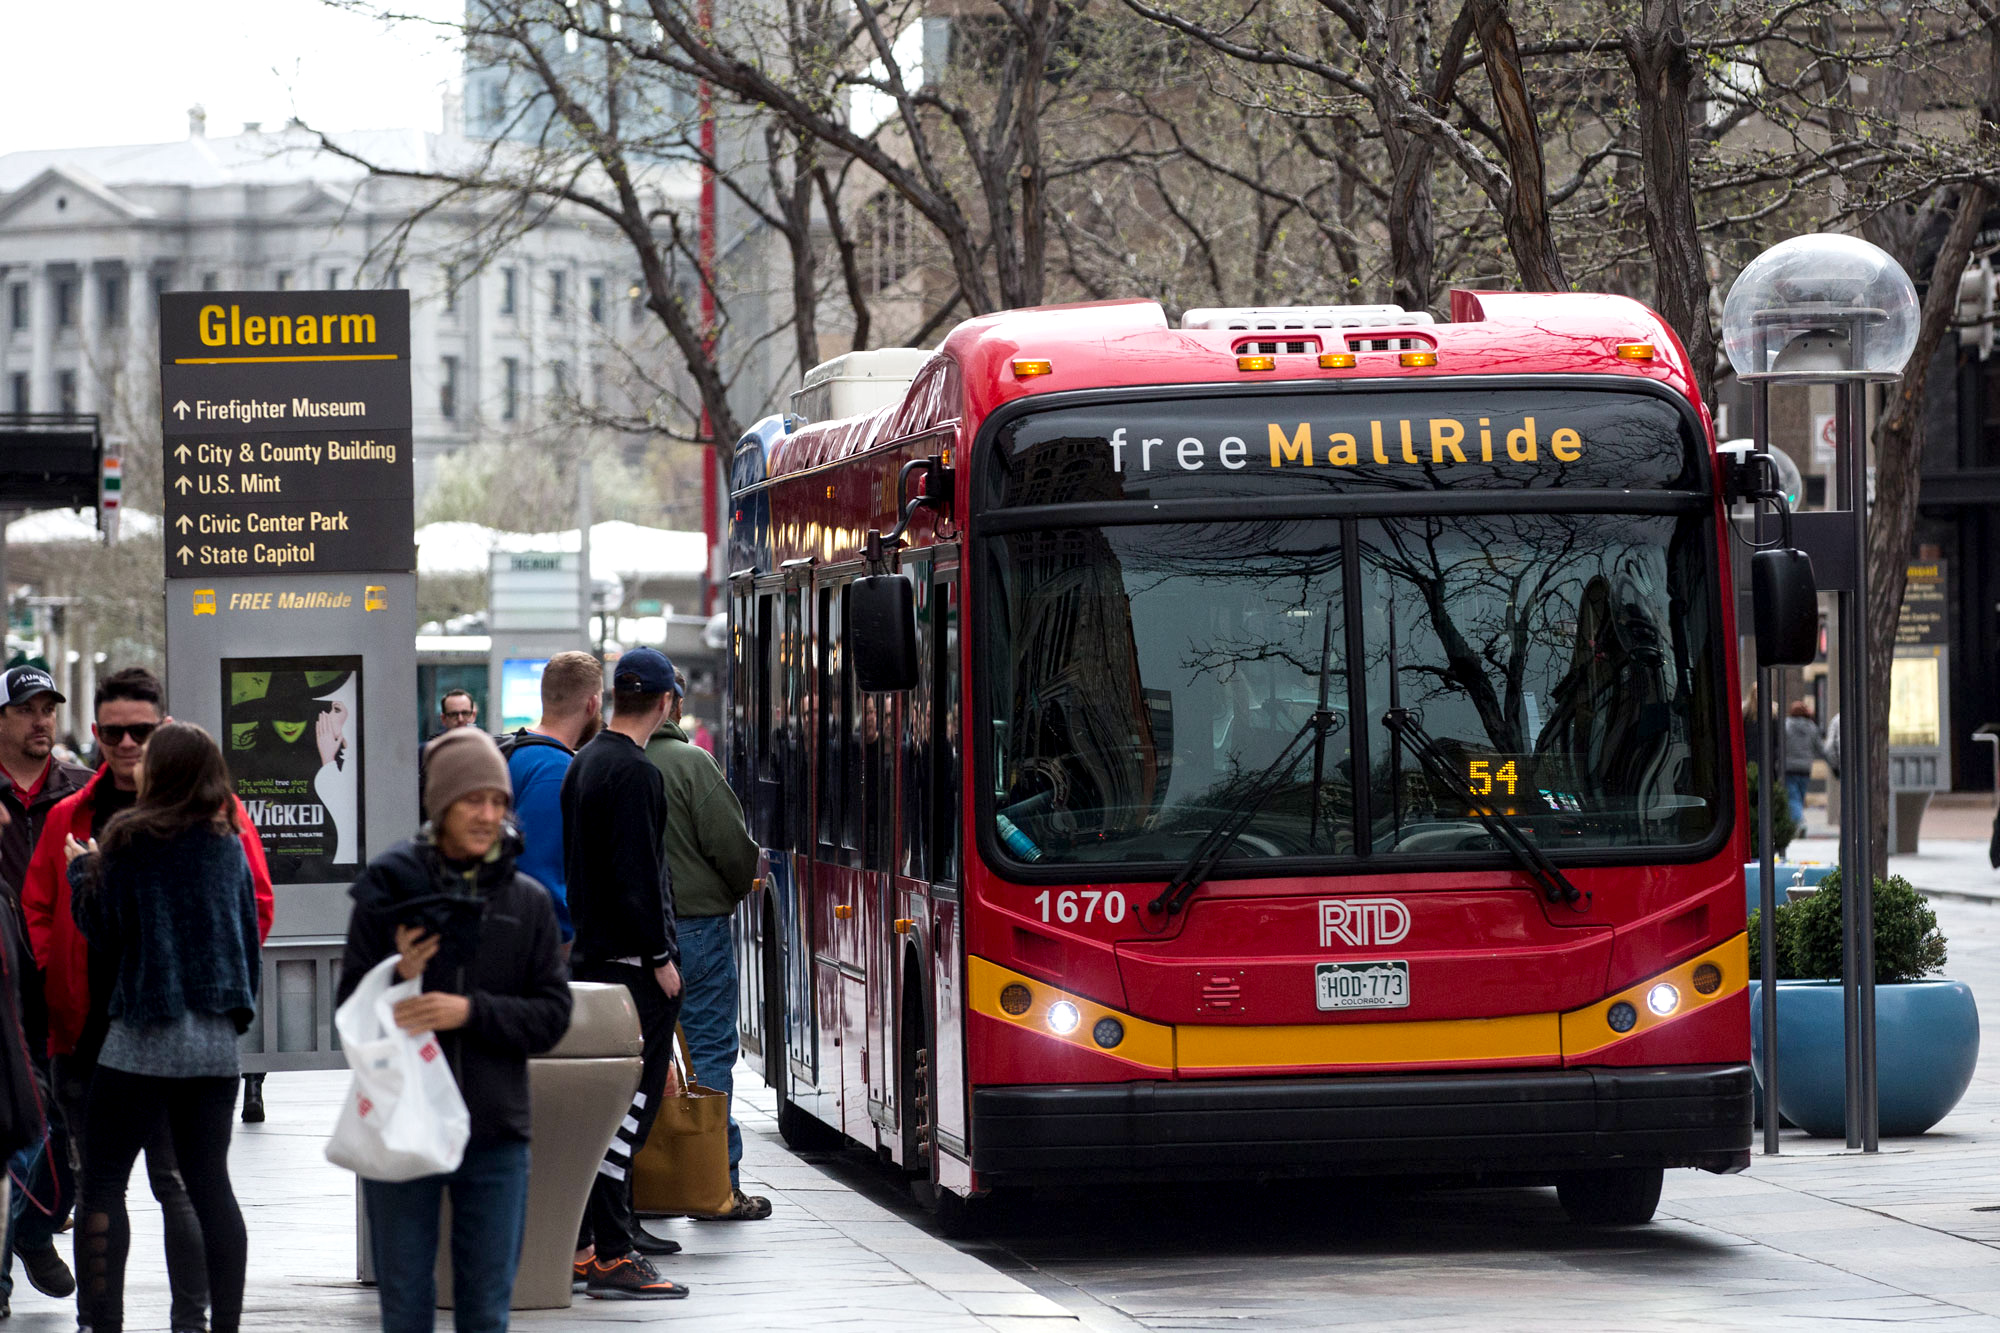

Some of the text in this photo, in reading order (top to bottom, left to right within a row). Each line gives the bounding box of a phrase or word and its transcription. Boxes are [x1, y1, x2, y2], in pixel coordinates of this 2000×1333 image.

[199, 304, 376, 347] Glenarm
[196, 398, 366, 423] Firefighter Museum
[197, 440, 396, 467] City & County Building
[1109, 416, 1583, 473] free MallRide
[198, 473, 281, 494] U.S. Mint
[199, 511, 349, 534] Civic Center Park
[200, 542, 315, 566] State Capitol
[229, 591, 352, 611] FREE MallRide
[247, 786, 258, 794] the
[260, 786, 286, 794] Witches
[288, 786, 296, 794] of
[253, 778, 274, 786] untold
[291, 779, 308, 788] story
[1469, 760, 1518, 796] 54
[1034, 890, 1126, 923] 1670
[1318, 897, 1411, 947] RTD
[1341, 998, 1386, 1006] COLORADO
